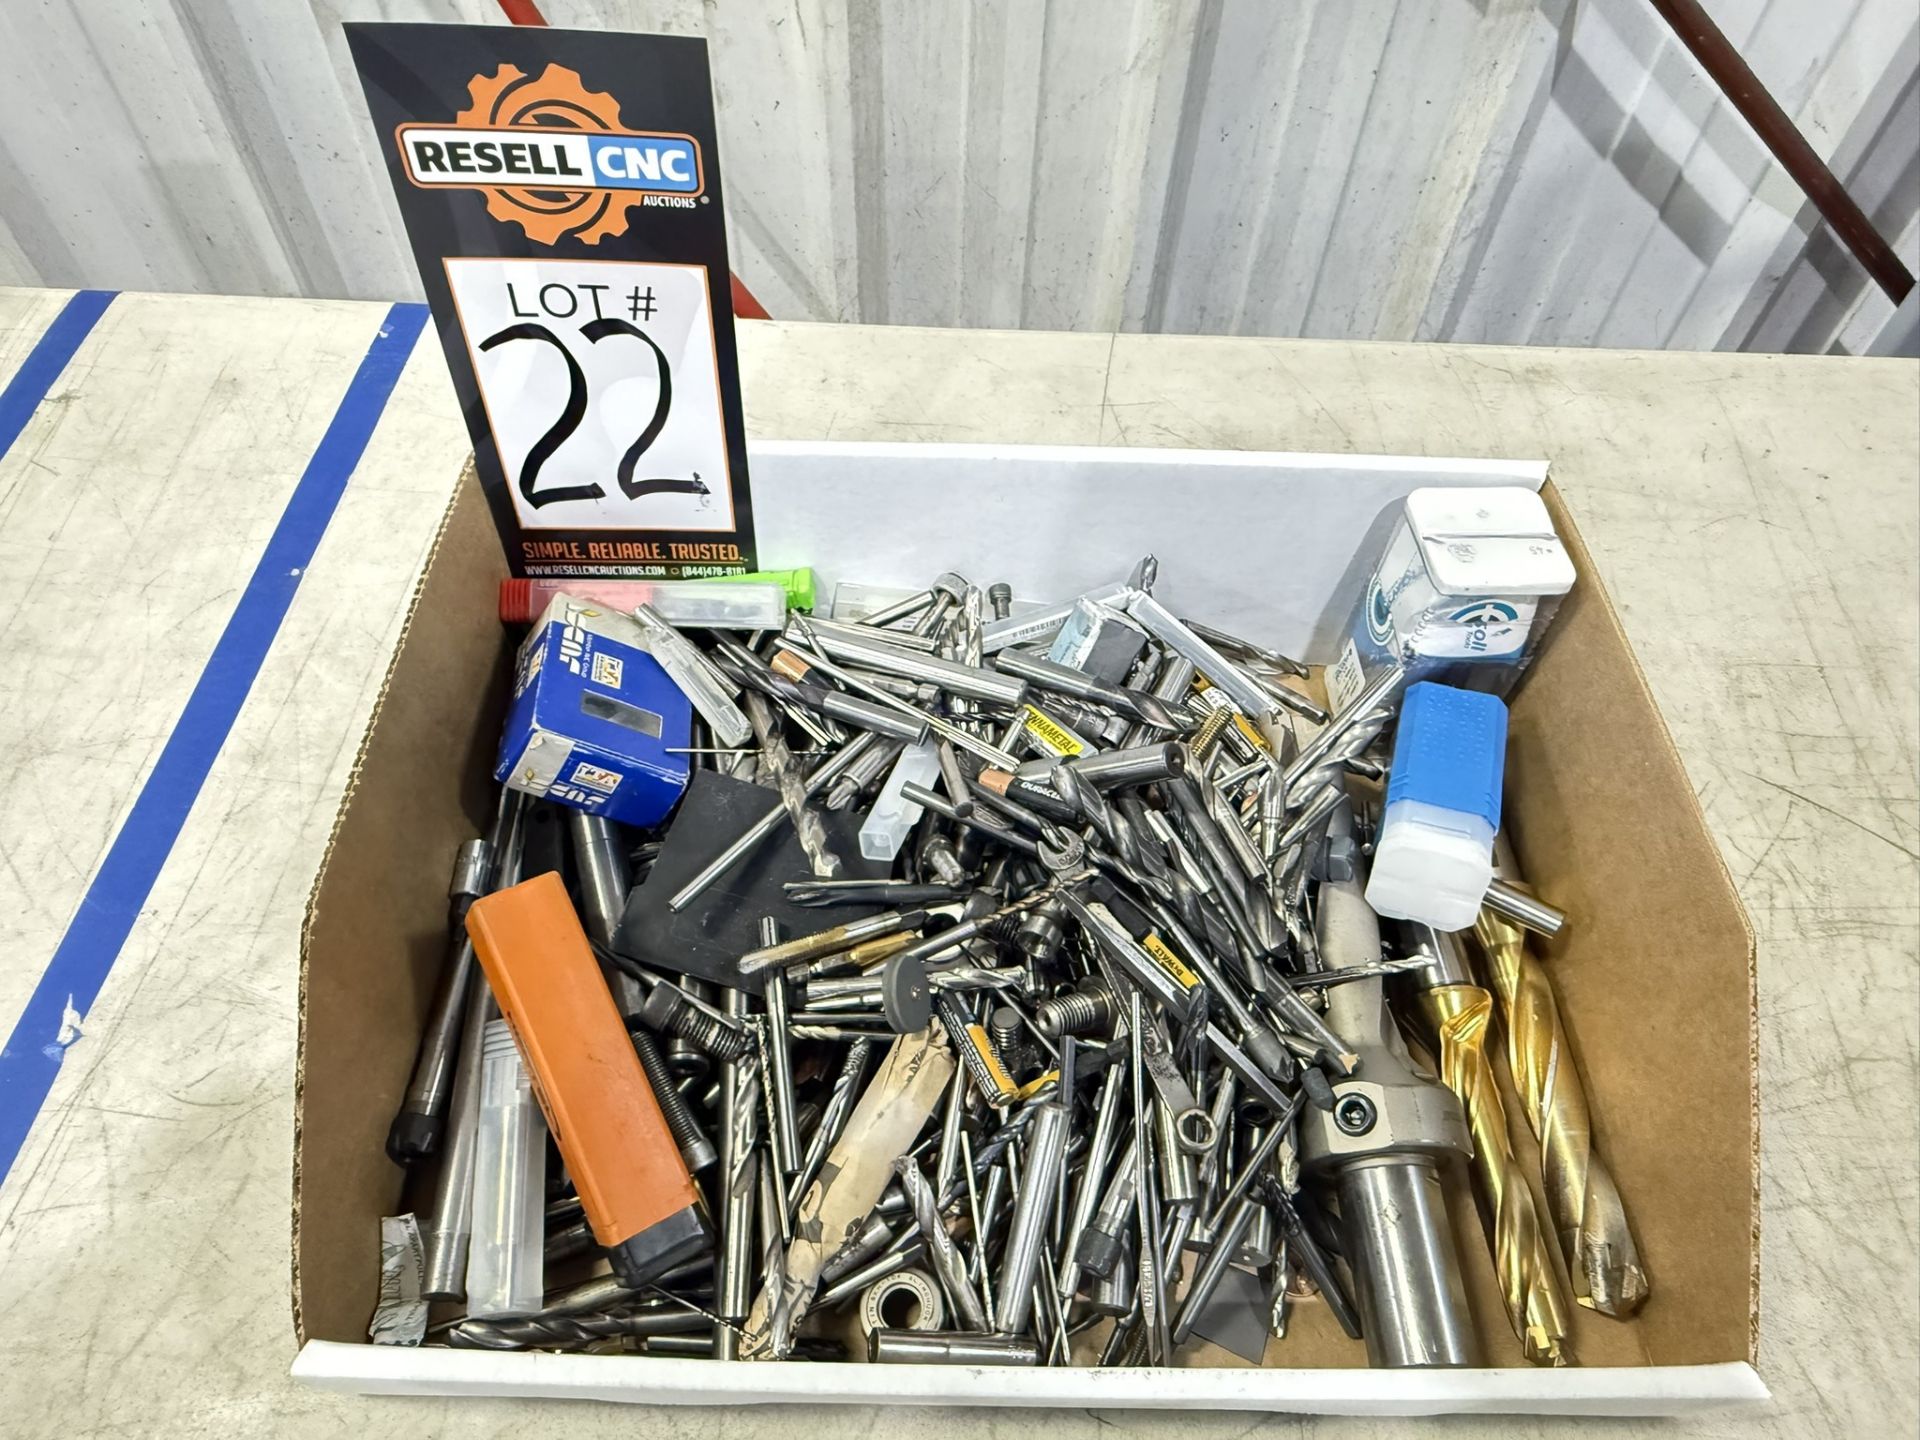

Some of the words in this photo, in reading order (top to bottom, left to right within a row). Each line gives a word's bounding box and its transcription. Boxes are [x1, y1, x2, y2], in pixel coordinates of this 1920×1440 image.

[413, 141, 583, 176] RESELL
[596, 145, 691, 182] CNC
[643, 195, 697, 209] AUCTIONS
[507, 283, 610, 320] LOT
[626, 286, 658, 321] #
[478, 318, 711, 510] 22
[522, 541, 587, 559] SIMPLE.
[588, 541, 667, 560] RELIABLE.
[668, 542, 744, 561] TRUSTED.
